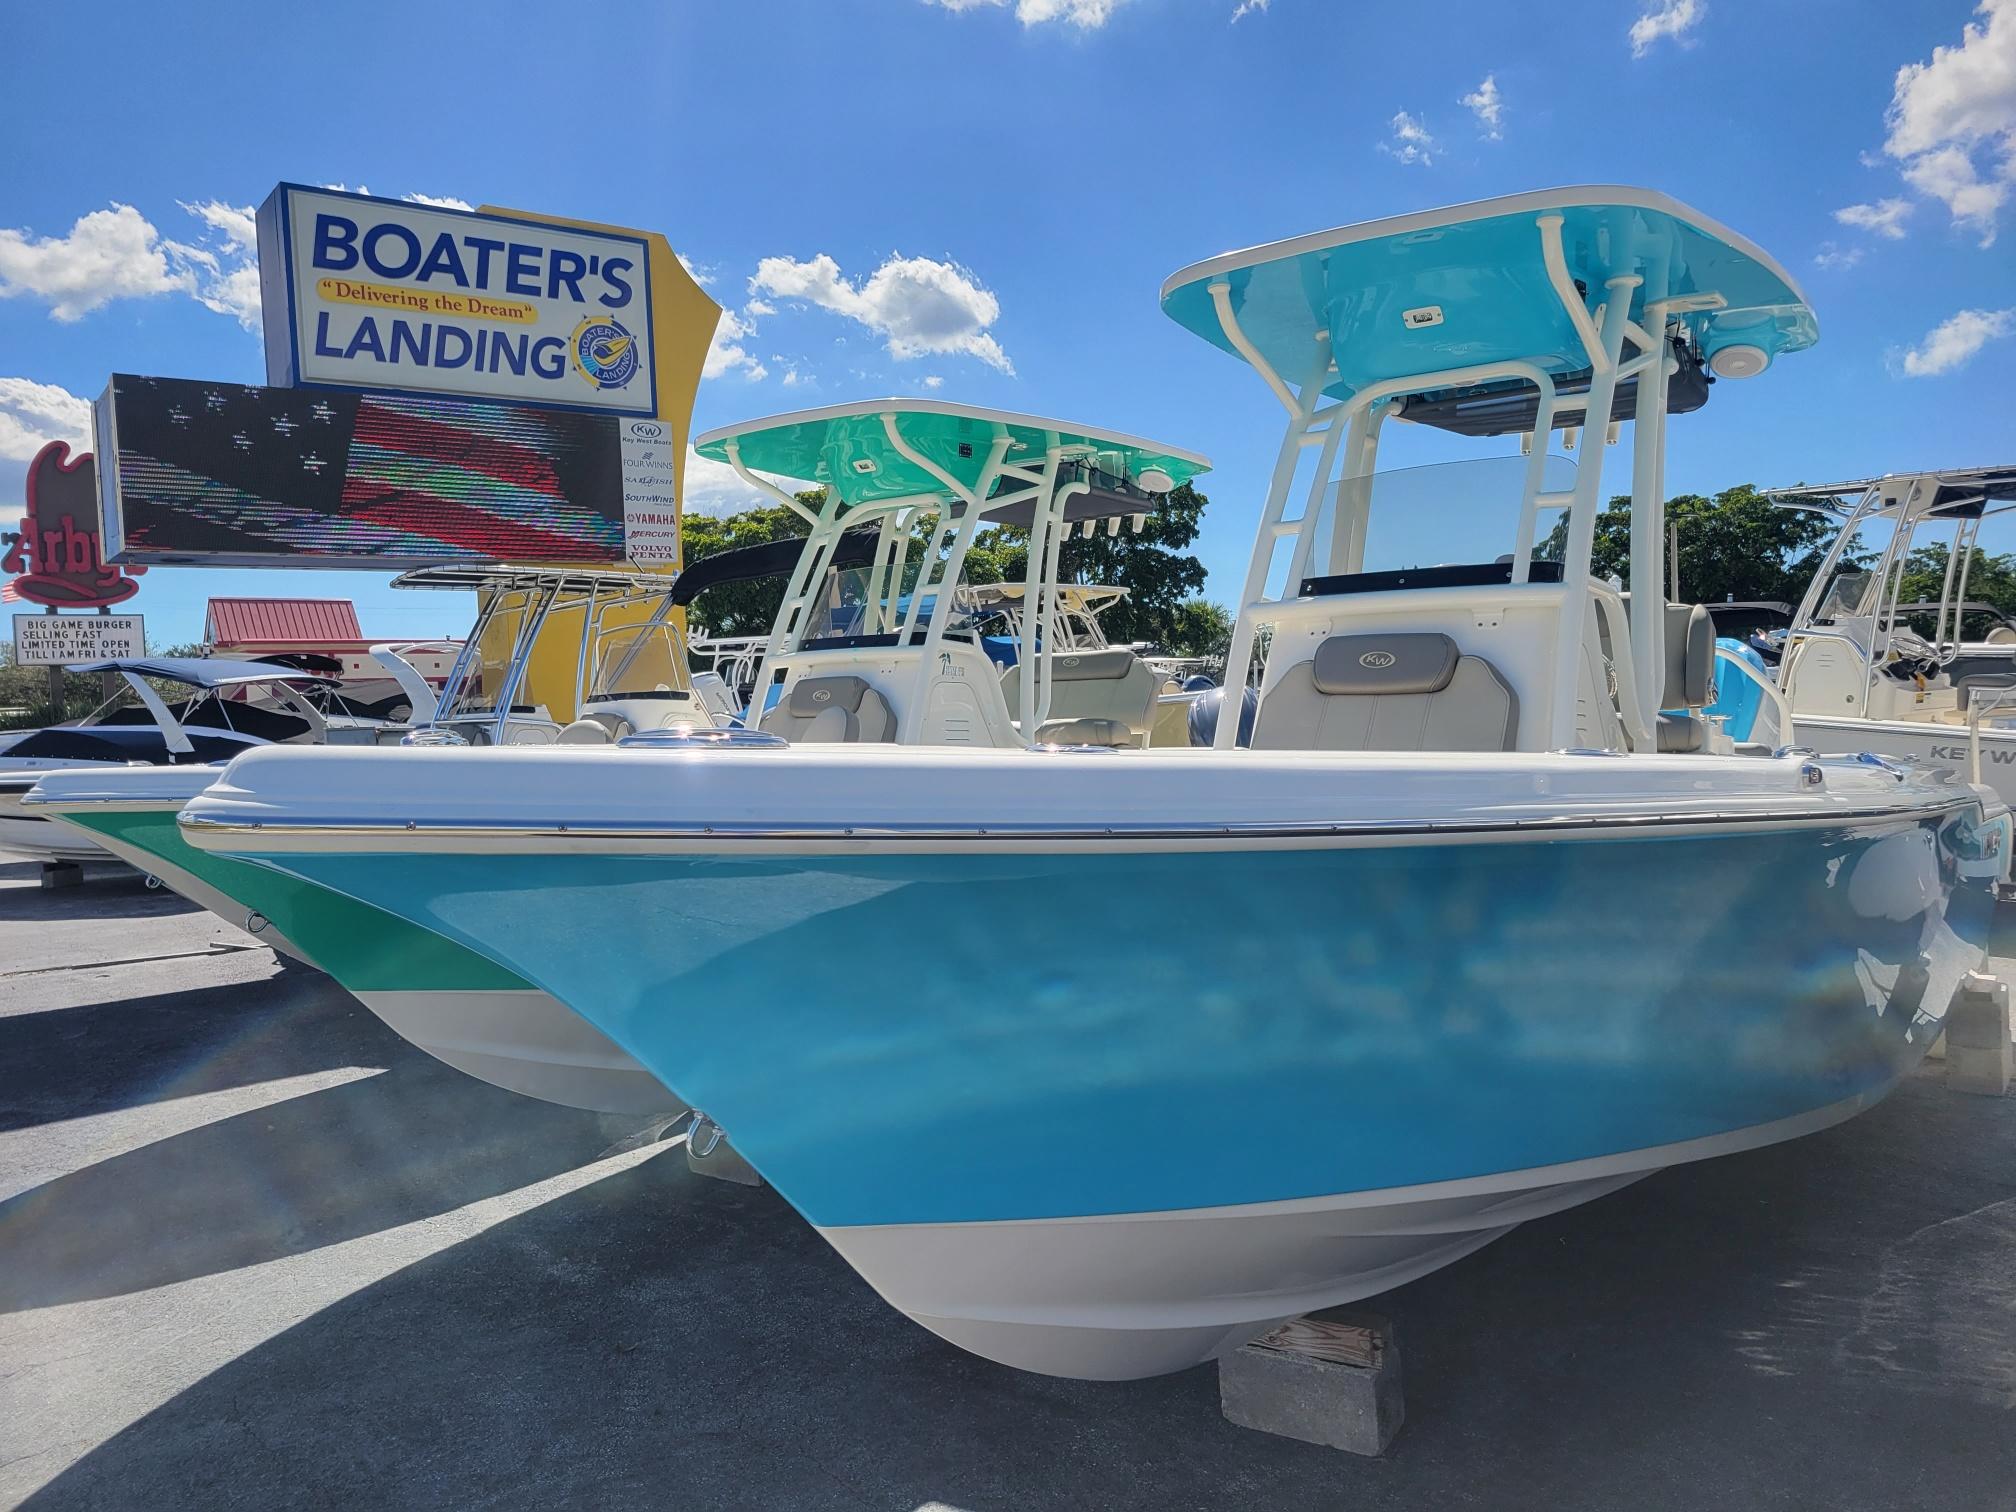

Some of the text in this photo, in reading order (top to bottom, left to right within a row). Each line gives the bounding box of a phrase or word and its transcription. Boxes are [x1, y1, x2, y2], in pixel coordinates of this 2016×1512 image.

[312, 213, 635, 309] BOATER'S
[435, 296, 462, 312] the
[315, 311, 567, 380] LANDING
[596, 352, 631, 380] LANDING
[635, 513, 676, 526] YAMAHA
[628, 530, 676, 539] MERCURY
[632, 544, 672, 553] VOLVO
[27, 621, 132, 630] BIG GAME BURGER
[23, 631, 102, 640] SELLING FAST
[70, 641, 96, 649] TIME
[102, 640, 130, 649] OPEN
[25, 650, 48, 659] TILL
[60, 650, 75, 659] AM
[79, 650, 96, 659] FRI
[101, 650, 107, 658] &
[111, 650, 131, 658] SAT
